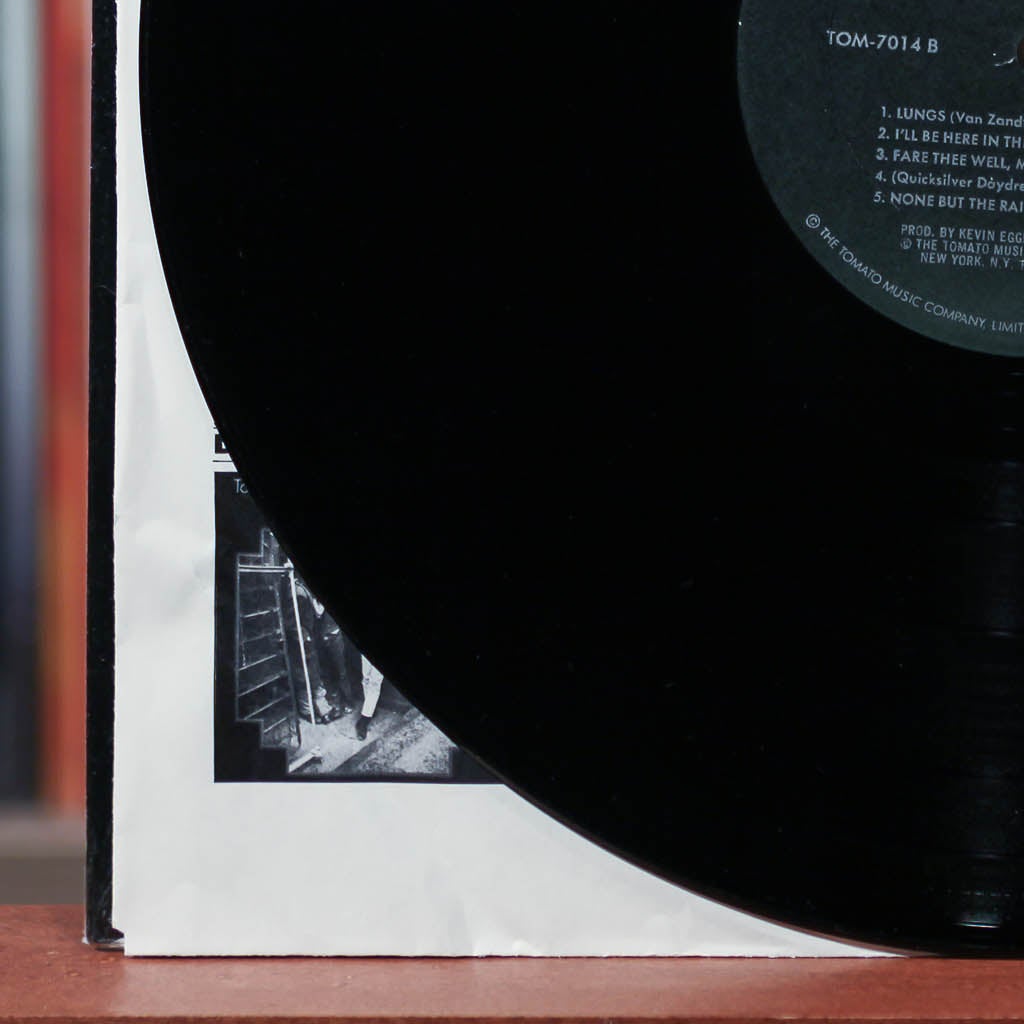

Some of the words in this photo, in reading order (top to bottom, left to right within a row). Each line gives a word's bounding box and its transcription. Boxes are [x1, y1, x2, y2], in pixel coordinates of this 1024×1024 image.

[826, 29, 921, 52] TOM-7014
[927, 38, 938, 53] B
[880, 106, 892, 119] 1.
[896, 107, 946, 122] LUNGS
[949, 111, 983, 125] (Van
[877, 127, 890, 140] 2.
[922, 130, 940, 144] BE
[943, 131, 979, 145] HERE
[983, 134, 1000, 148] IN
[875, 148, 889, 161] 3.
[892, 149, 929, 164] FARE
[932, 152, 968, 167] THEE
[970, 154, 1011, 171] WELL,
[874, 170, 887, 183] 4.
[891, 170, 973, 189] (Quicksilver
[872, 191, 886, 204] 5.
[889, 192, 935, 208] NONE
[937, 195, 965, 209] BUT
[969, 197, 996, 211] THE
[900, 224, 935, 238] PROD.
[939, 226, 956, 239] BY
[959, 228, 996, 242] KEVIN
[916, 238, 938, 252] THE
[942, 240, 990, 255] TOMATO
[819, 226, 841, 250] THE
[838, 245, 883, 285] TOMATO
[882, 280, 923, 308] MUSIC
[920, 252, 948, 264] NEW
